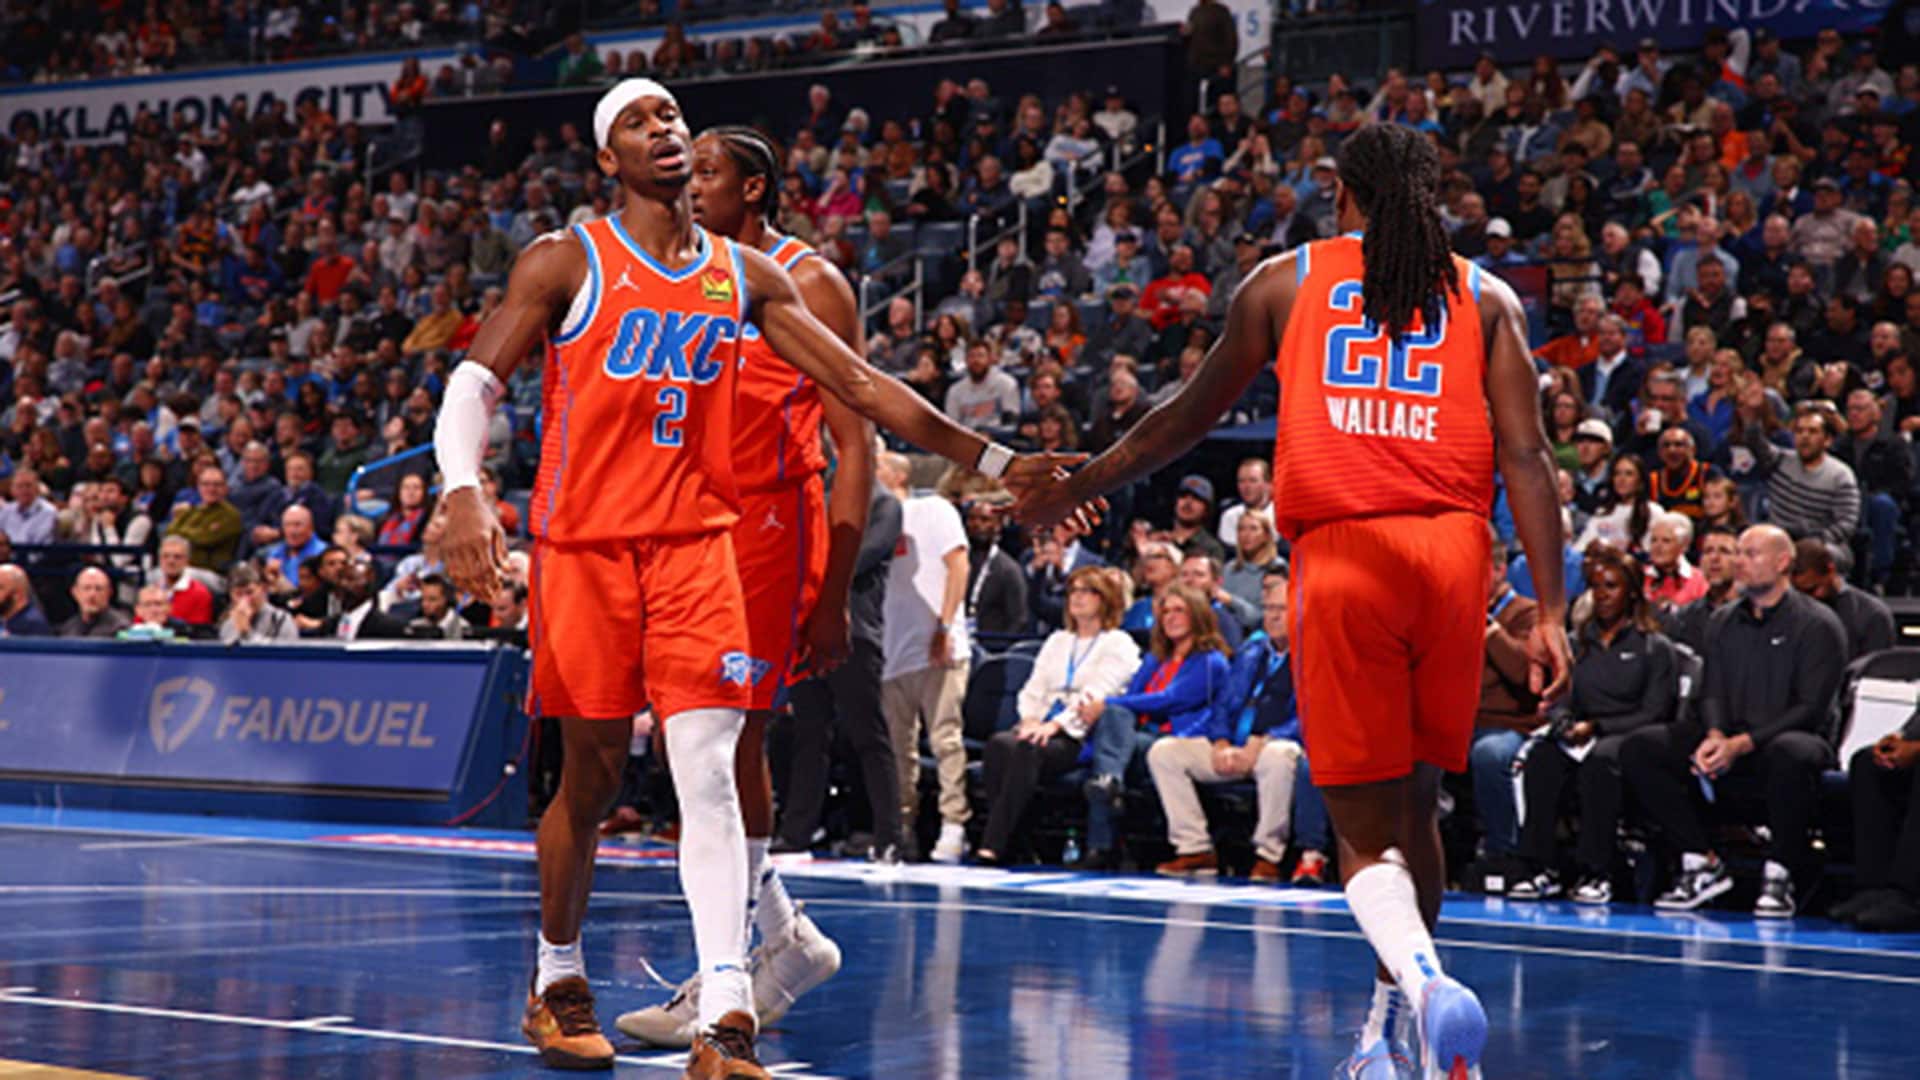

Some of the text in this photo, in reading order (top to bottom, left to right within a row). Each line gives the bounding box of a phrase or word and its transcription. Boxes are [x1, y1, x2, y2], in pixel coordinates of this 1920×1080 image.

[604, 307, 738, 384] OKC
[1323, 279, 1447, 396] 22
[653, 387, 686, 447] 2
[1325, 395, 1439, 442] WALLACE
[214, 696, 436, 748] FANDUEL
